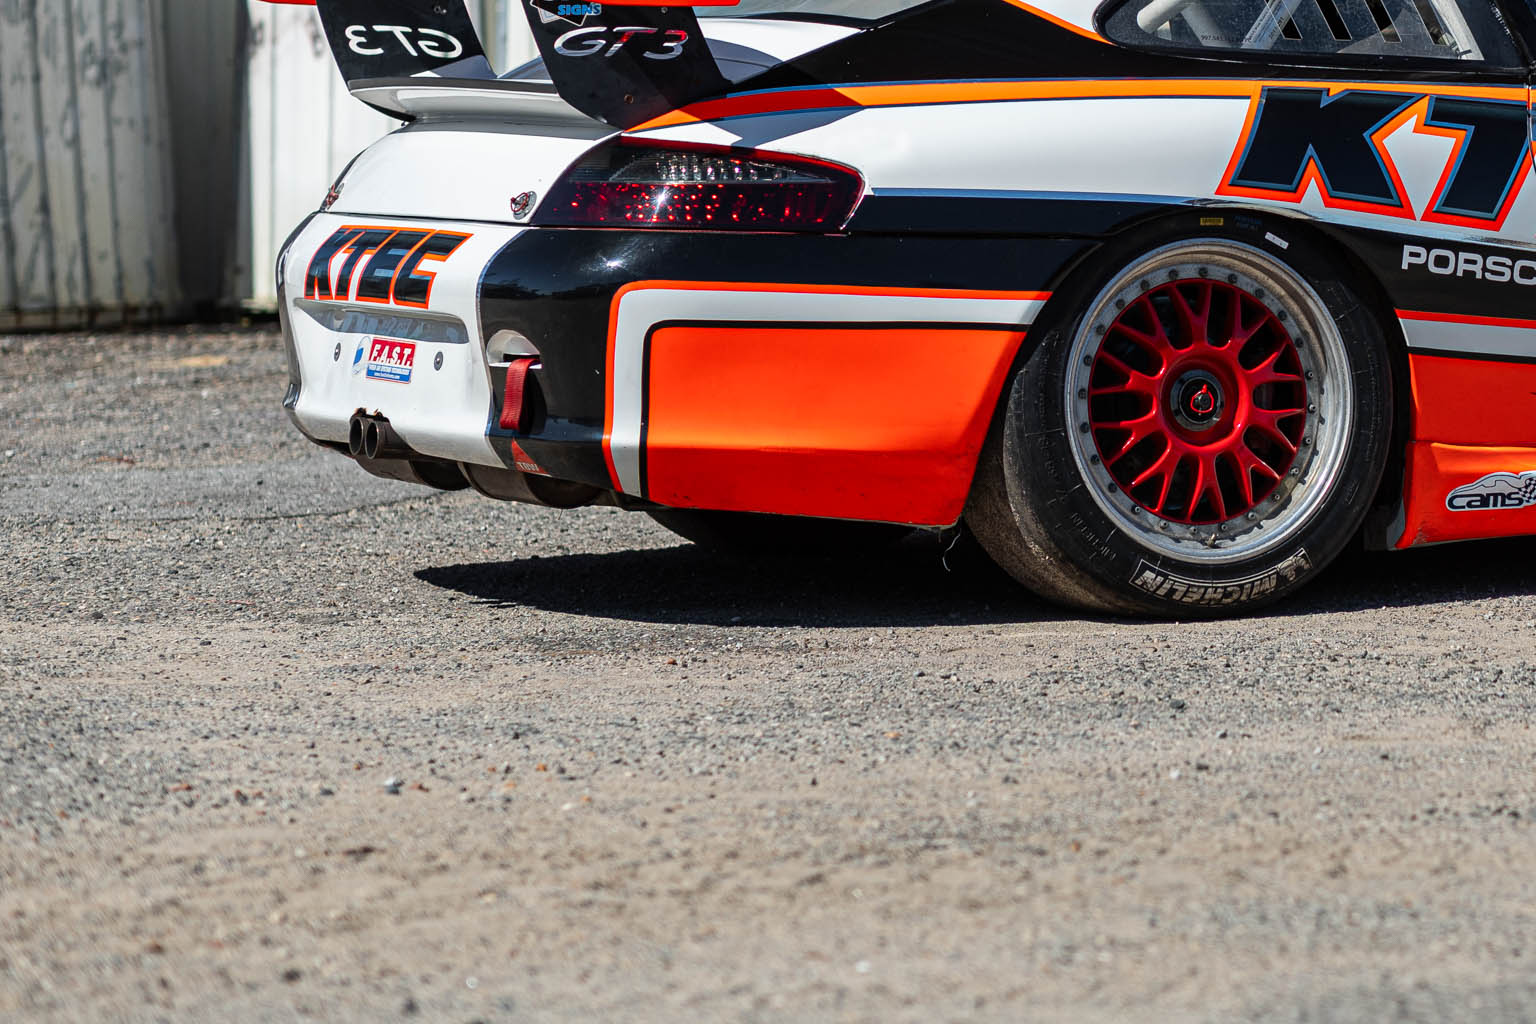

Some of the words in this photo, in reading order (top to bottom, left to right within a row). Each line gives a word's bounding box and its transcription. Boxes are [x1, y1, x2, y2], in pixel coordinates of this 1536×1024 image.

[557, 2, 602, 16] SIGNS
[554, 26, 689, 60] GT3
[304, 225, 474, 309] KTEC
[1134, 568, 1278, 607] MICHELIN
